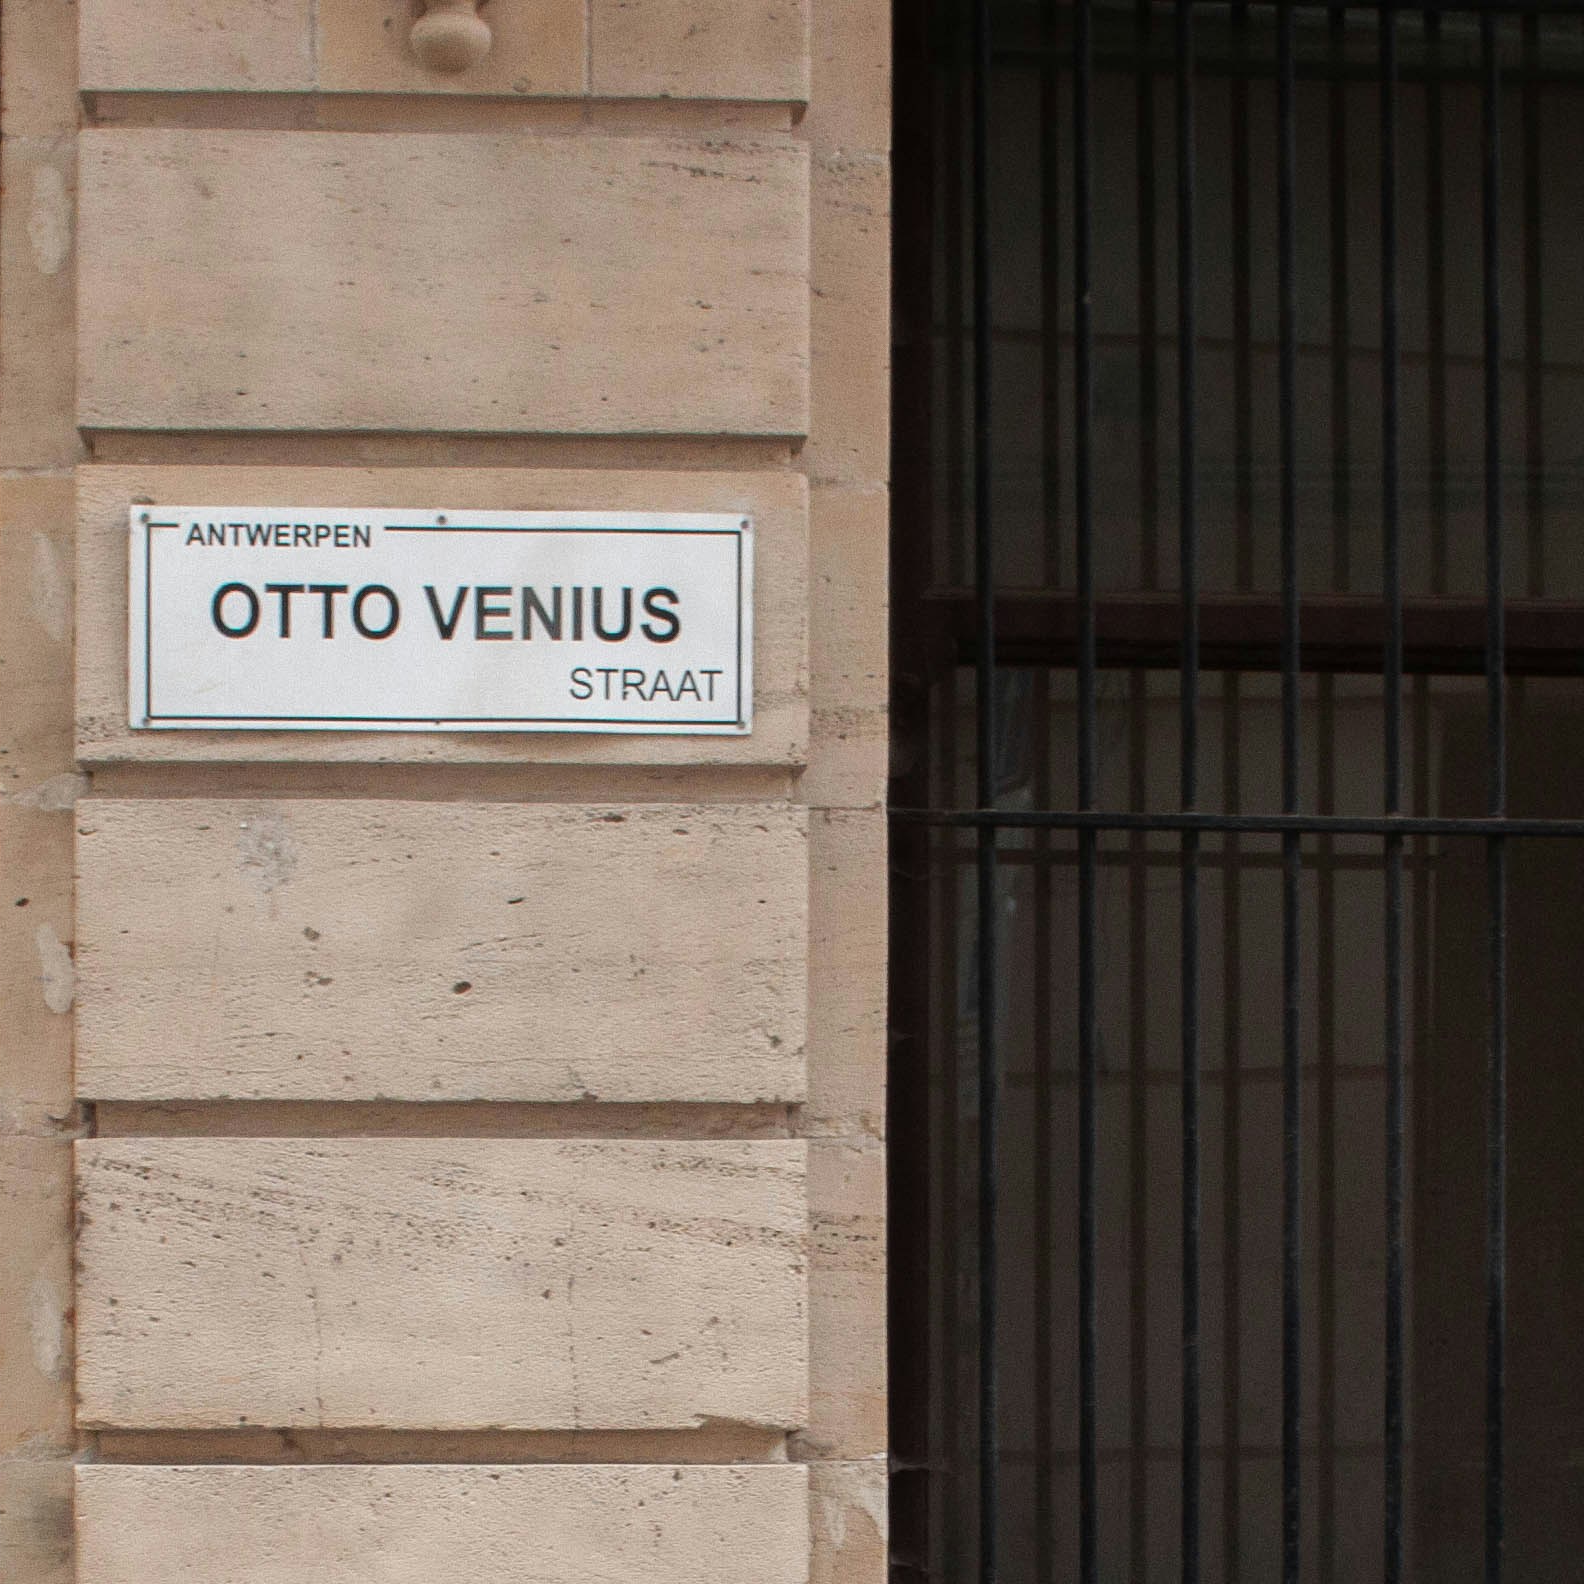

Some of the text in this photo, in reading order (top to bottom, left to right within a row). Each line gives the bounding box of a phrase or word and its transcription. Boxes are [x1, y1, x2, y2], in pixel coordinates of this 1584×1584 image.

[186, 522, 371, 549] ANTWERPEN
[211, 582, 681, 644] OTTO VENIUS
[569, 667, 723, 702] STRAAT
